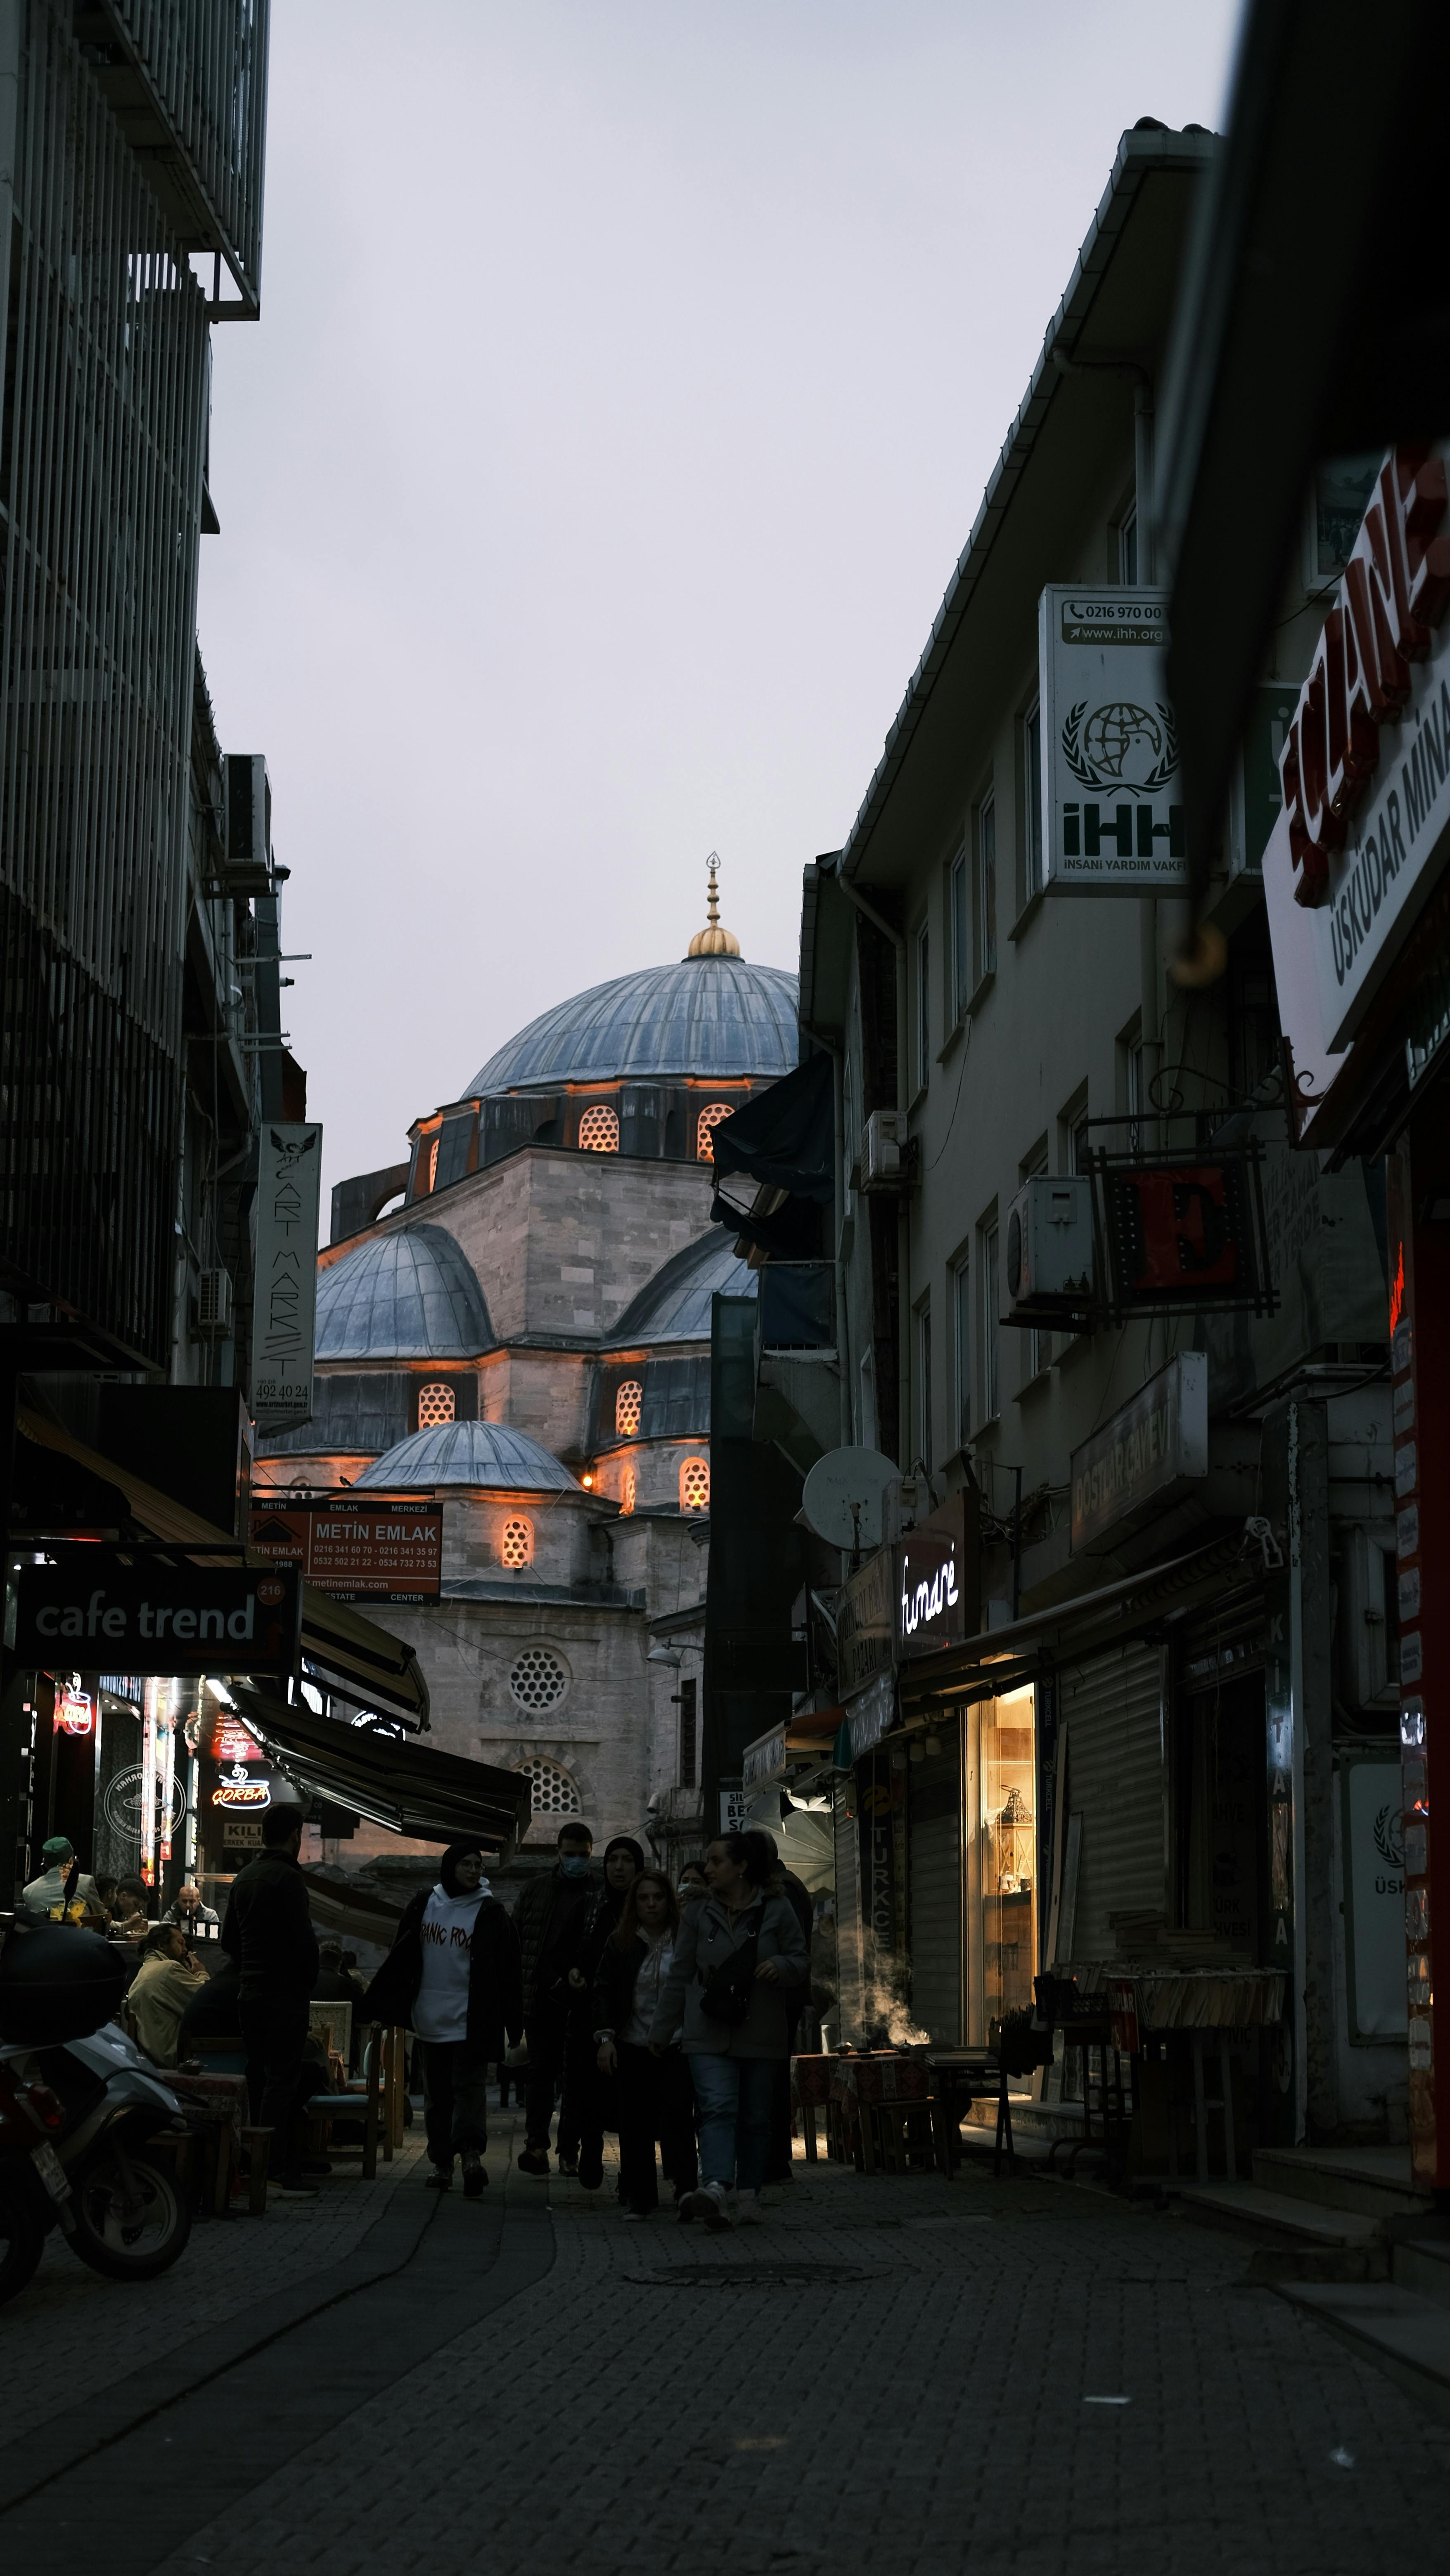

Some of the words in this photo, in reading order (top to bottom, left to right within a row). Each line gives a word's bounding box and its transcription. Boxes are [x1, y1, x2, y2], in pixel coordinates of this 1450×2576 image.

[1086, 606, 1114, 618] 0216
[1118, 606, 1141, 619] 970
[1105, 860, 1150, 870] YARDIM
[1330, 789, 1407, 987] ÜSKÜDAR
[274, 1183, 301, 1236] ART
[259, 1251, 306, 1376] MARKET
[256, 1385, 276, 1400] 492
[279, 1385, 292, 1400] 40
[296, 1385, 308, 1400] 24
[261, 1501, 287, 1510] METİN
[391, 1504, 428, 1513] MERKEZİ
[316, 1521, 369, 1539] METİN
[375, 1525, 437, 1541] EMLAK
[272, 1546, 303, 1556] EMLAK
[261, 1585, 281, 1596] 216
[36, 1590, 128, 1638] cafe
[137, 1593, 255, 1640] trend
[212, 1787, 267, 1805] ÇORBA
